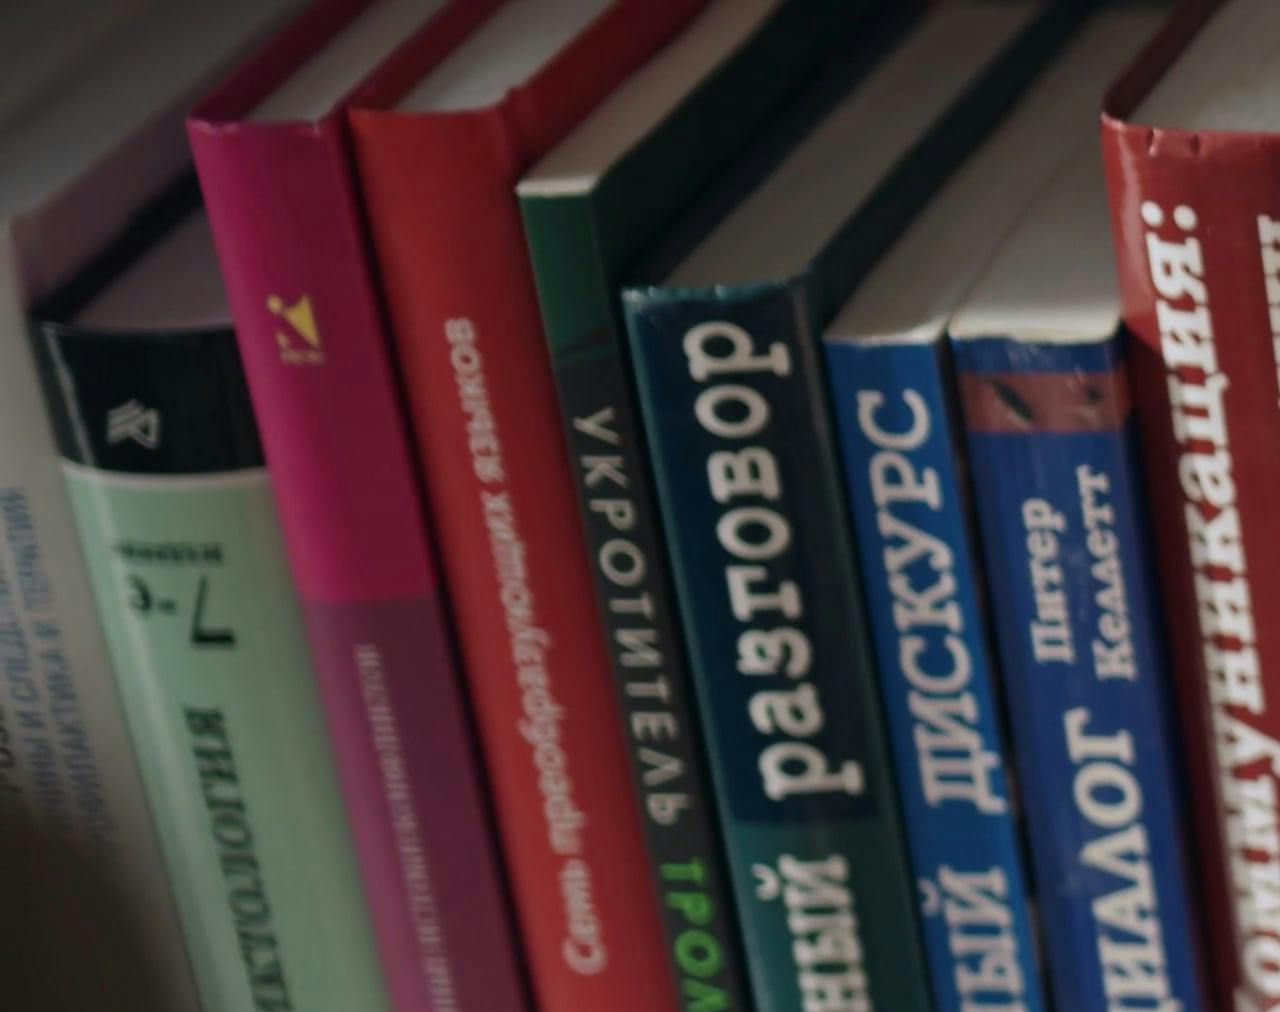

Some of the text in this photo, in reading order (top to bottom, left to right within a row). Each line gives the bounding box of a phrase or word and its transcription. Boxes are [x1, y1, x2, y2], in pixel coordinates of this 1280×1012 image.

[573, 406, 691, 826] УКРОТИТЕЛЬ
[683, 320, 864, 802] разговор
[856, 388, 1009, 814] ДИСКУРС
[1022, 498, 1076, 664] Питер
